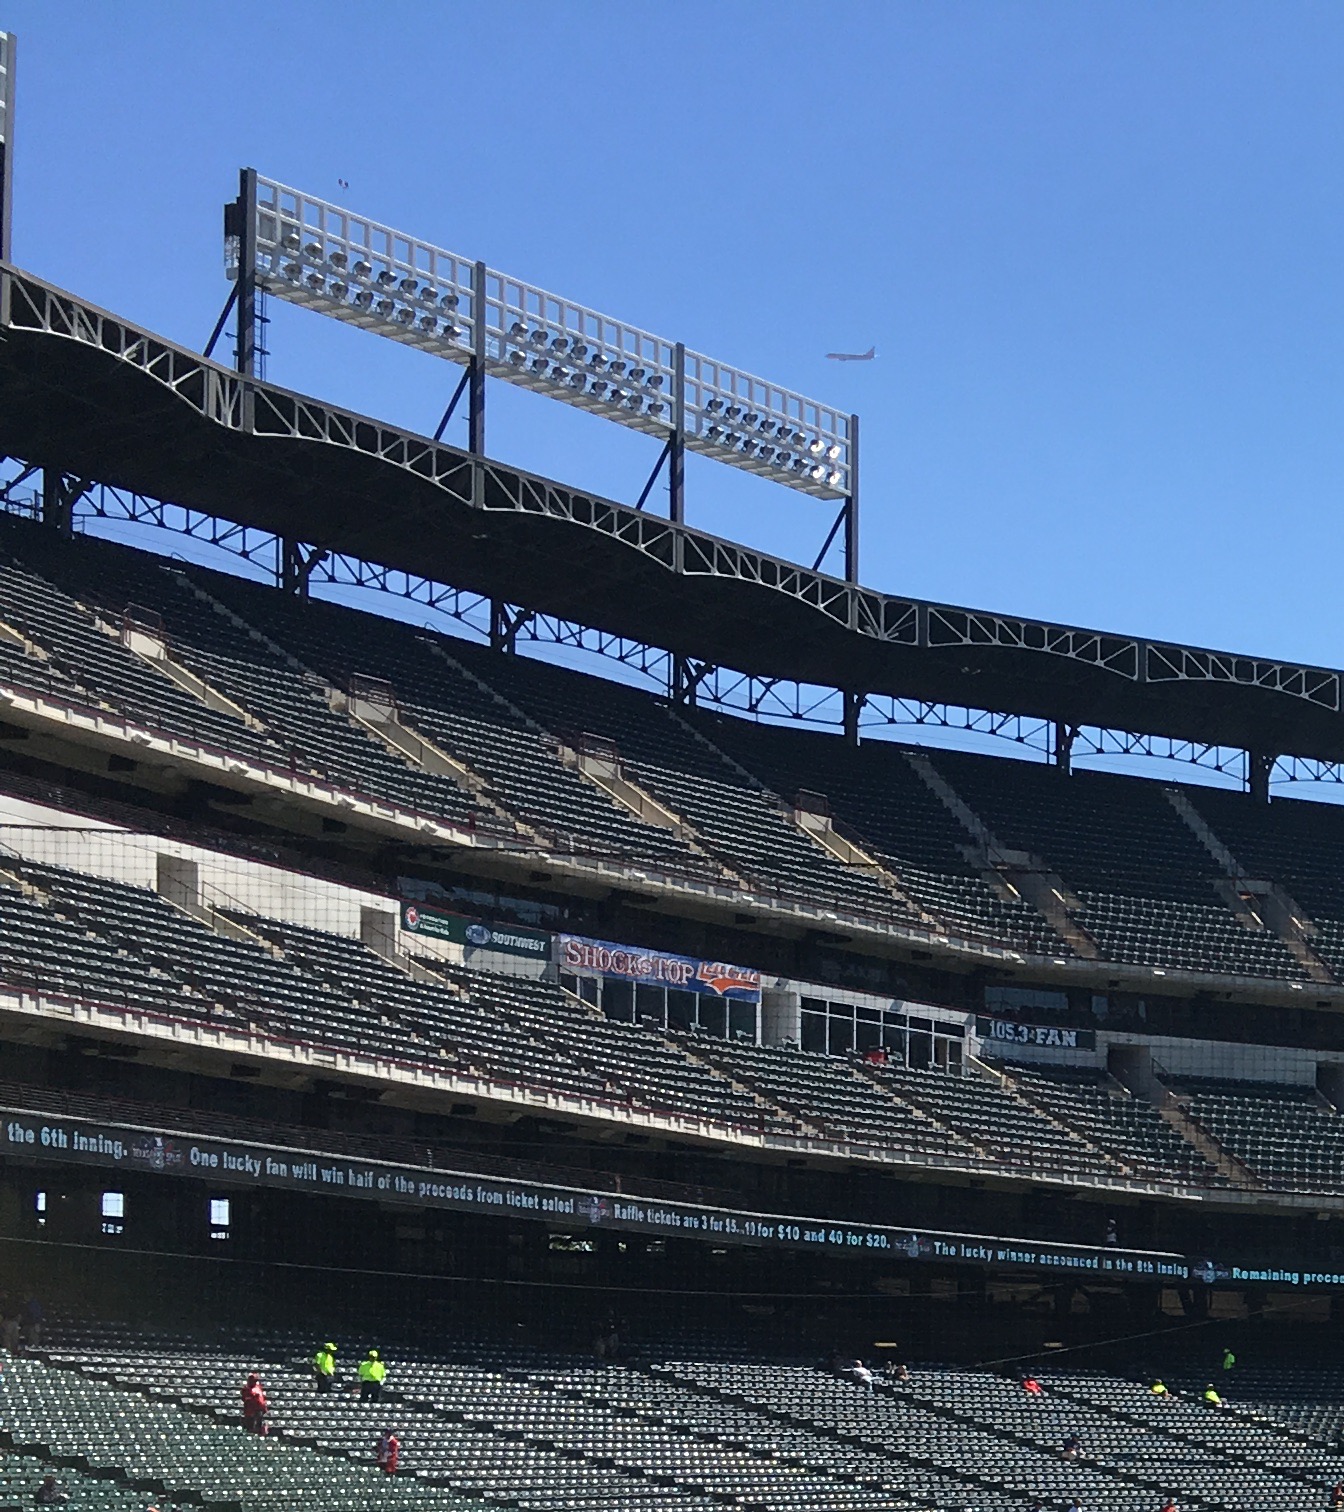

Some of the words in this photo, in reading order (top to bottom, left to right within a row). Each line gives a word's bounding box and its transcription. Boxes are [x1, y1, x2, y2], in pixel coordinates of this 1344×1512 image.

[491, 931, 546, 952] SOUTHWEST
[653, 956, 695, 984] TOP
[990, 1020, 1028, 1042] 105.3
[1035, 1028, 1077, 1047] FAN
[8, 1122, 35, 1144] the
[40, 1126, 68, 1149] 6th
[74, 1131, 128, 1160] inning.
[190, 1147, 218, 1168] One
[223, 1151, 261, 1177] lucky
[266, 1157, 287, 1177] fan
[292, 1161, 317, 1181] will
[321, 1166, 344, 1185] win
[348, 1168, 373, 1189] half
[378, 1173, 391, 1190] of
[395, 1175, 415, 1194] the
[418, 1182, 473, 1202] proceeds
[477, 1186, 503, 1205] from
[506, 1190, 539, 1210] ticket
[614, 1203, 645, 1222] Raffle
[647, 1208, 681, 1227] tickets
[683, 1215, 699, 1229] are
[701, 1215, 708, 1230] 3
[710, 1216, 723, 1232] for
[757, 1222, 774, 1238] for
[777, 1224, 800, 1241] $10
[803, 1228, 825, 1243] and
[828, 1229, 843, 1245] 40
[846, 1231, 863, 1246] for
[866, 1232, 891, 1249] $20.
[933, 1241, 957, 1258] The
[960, 1243, 993, 1262] lucky
[998, 1248, 1036, 1264] winner
[1039, 1253, 1099, 1269] announced
[1102, 1257, 1112, 1270] in
[1116, 1257, 1133, 1272] the
[1136, 1260, 1154, 1273] 8th
[1156, 1261, 1189, 1279] inning
[1232, 1267, 1299, 1284] Remaining
